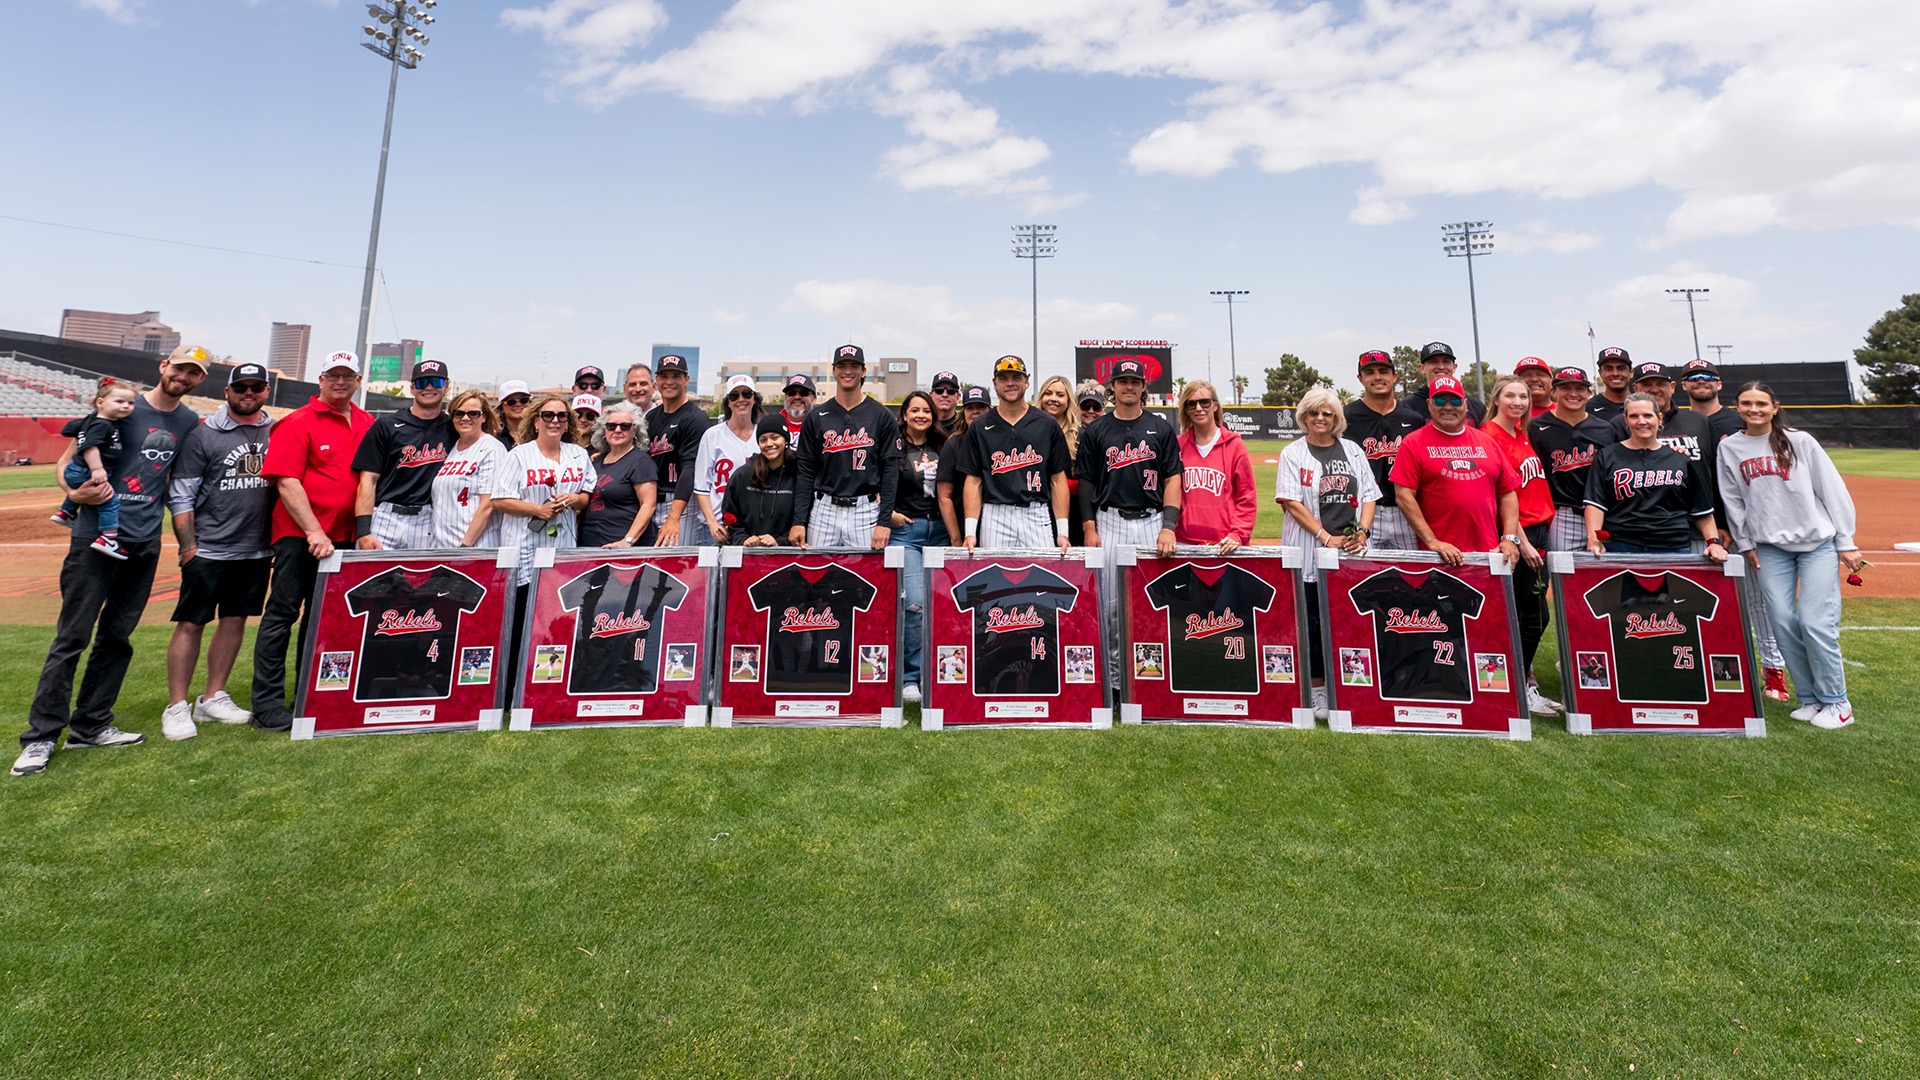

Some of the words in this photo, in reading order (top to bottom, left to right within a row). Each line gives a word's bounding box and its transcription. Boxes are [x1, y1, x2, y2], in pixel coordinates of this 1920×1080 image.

[332, 352, 352, 362] UNLV
[421, 361, 440, 372] UNLV
[1121, 361, 1139, 372] UNLV
[1641, 363, 1661, 374] UNLV
[1435, 377, 1456, 389] UNLV
[577, 398, 597, 406] UNLV
[1233, 414, 1253, 423] Evan
[823, 427, 874, 453] Rebels
[1363, 435, 1402, 458] Rebel
[224, 443, 264, 466] STANLY
[399, 442, 447, 467] Rebels
[852, 449, 867, 470] 12
[991, 444, 1043, 473] Rebels
[1106, 440, 1156, 470] Rebels
[1427, 446, 1487, 458] REBELS
[1551, 444, 1596, 471] Rebel
[225, 468, 237, 477] 20
[1325, 460, 1356, 477] VEGA
[1441, 467, 1487, 480] BASEBALL
[1451, 460, 1471, 470] UNLV
[1520, 456, 1545, 488] UNL
[1027, 470, 1042, 492] 14
[1182, 466, 1226, 496] UNLV
[1614, 468, 1684, 500] REBELS
[457, 486, 469, 507] 4
[376, 608, 442, 634] Rebels
[590, 609, 651, 637] Rebels
[779, 606, 840, 631] Rebels
[986, 605, 1045, 631] Rebels
[1185, 607, 1244, 638] Rebels
[1385, 607, 1449, 632] Rebels
[1625, 611, 1687, 637] Rebels
[426, 639, 439, 662] 4
[634, 638, 646, 661] 11
[824, 640, 840, 663] 12
[1031, 636, 1046, 660] 14
[1224, 636, 1245, 660] 20
[1433, 640, 1455, 666] 22
[1672, 645, 1695, 669] 25
